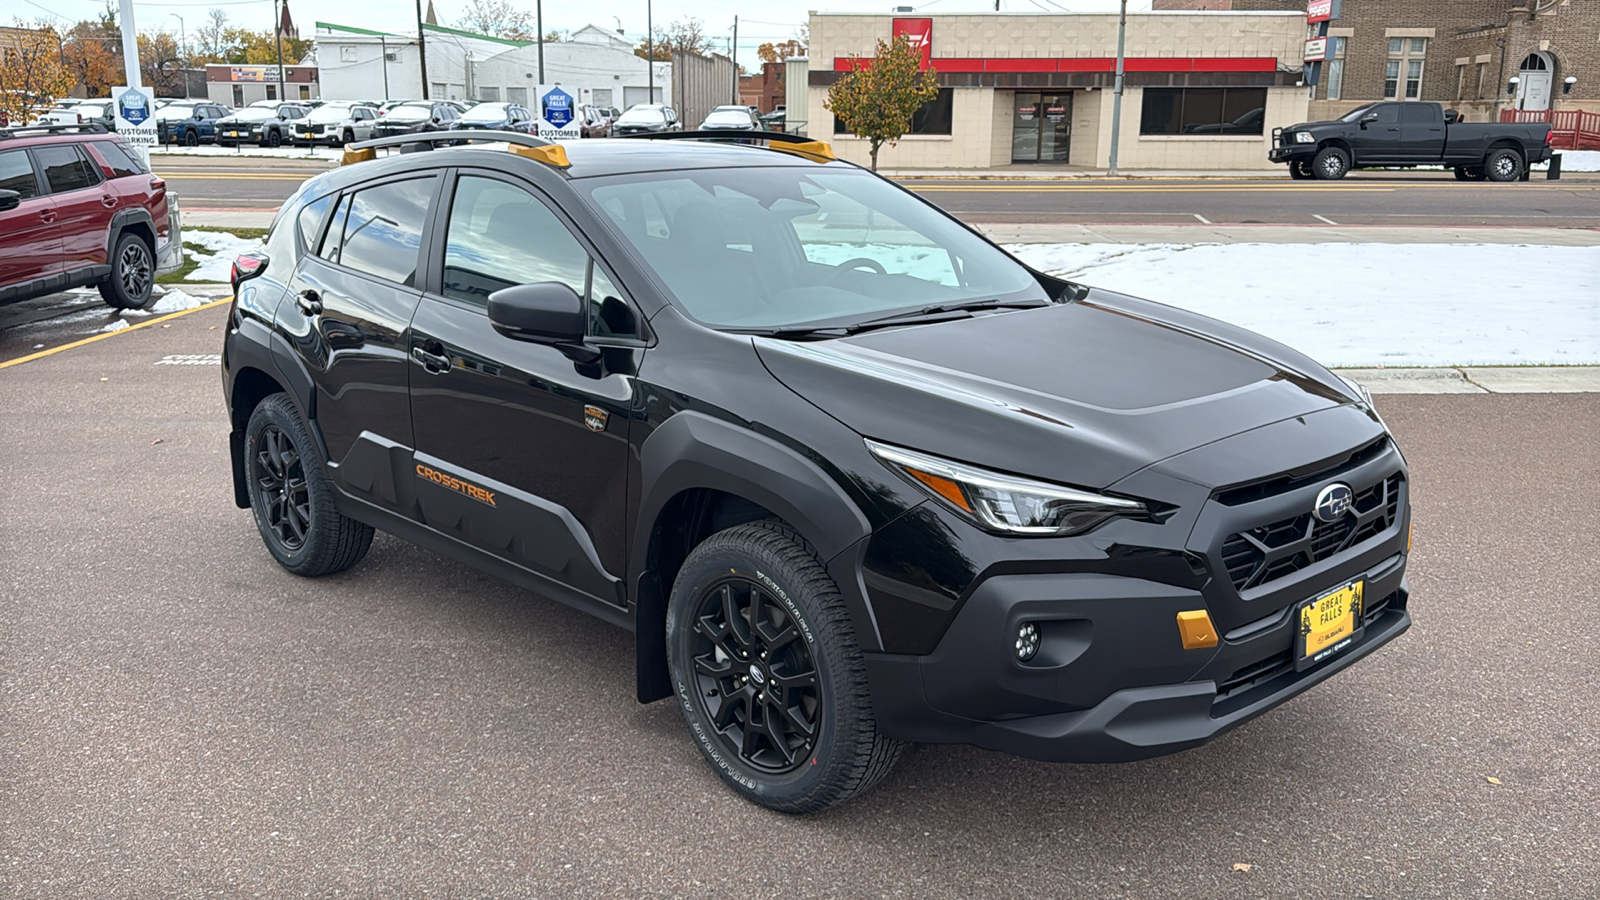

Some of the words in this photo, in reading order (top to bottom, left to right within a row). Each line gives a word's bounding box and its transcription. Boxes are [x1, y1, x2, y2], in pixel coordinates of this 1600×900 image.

[116, 128, 158, 136] CUSTOMER
[540, 129, 579, 137] CUSTOMER
[416, 464, 496, 506] CROSSTREK
[756, 570, 814, 643] YOKOHAMA
[1320, 594, 1343, 613] GREAT
[1320, 605, 1343, 626] FALLS
